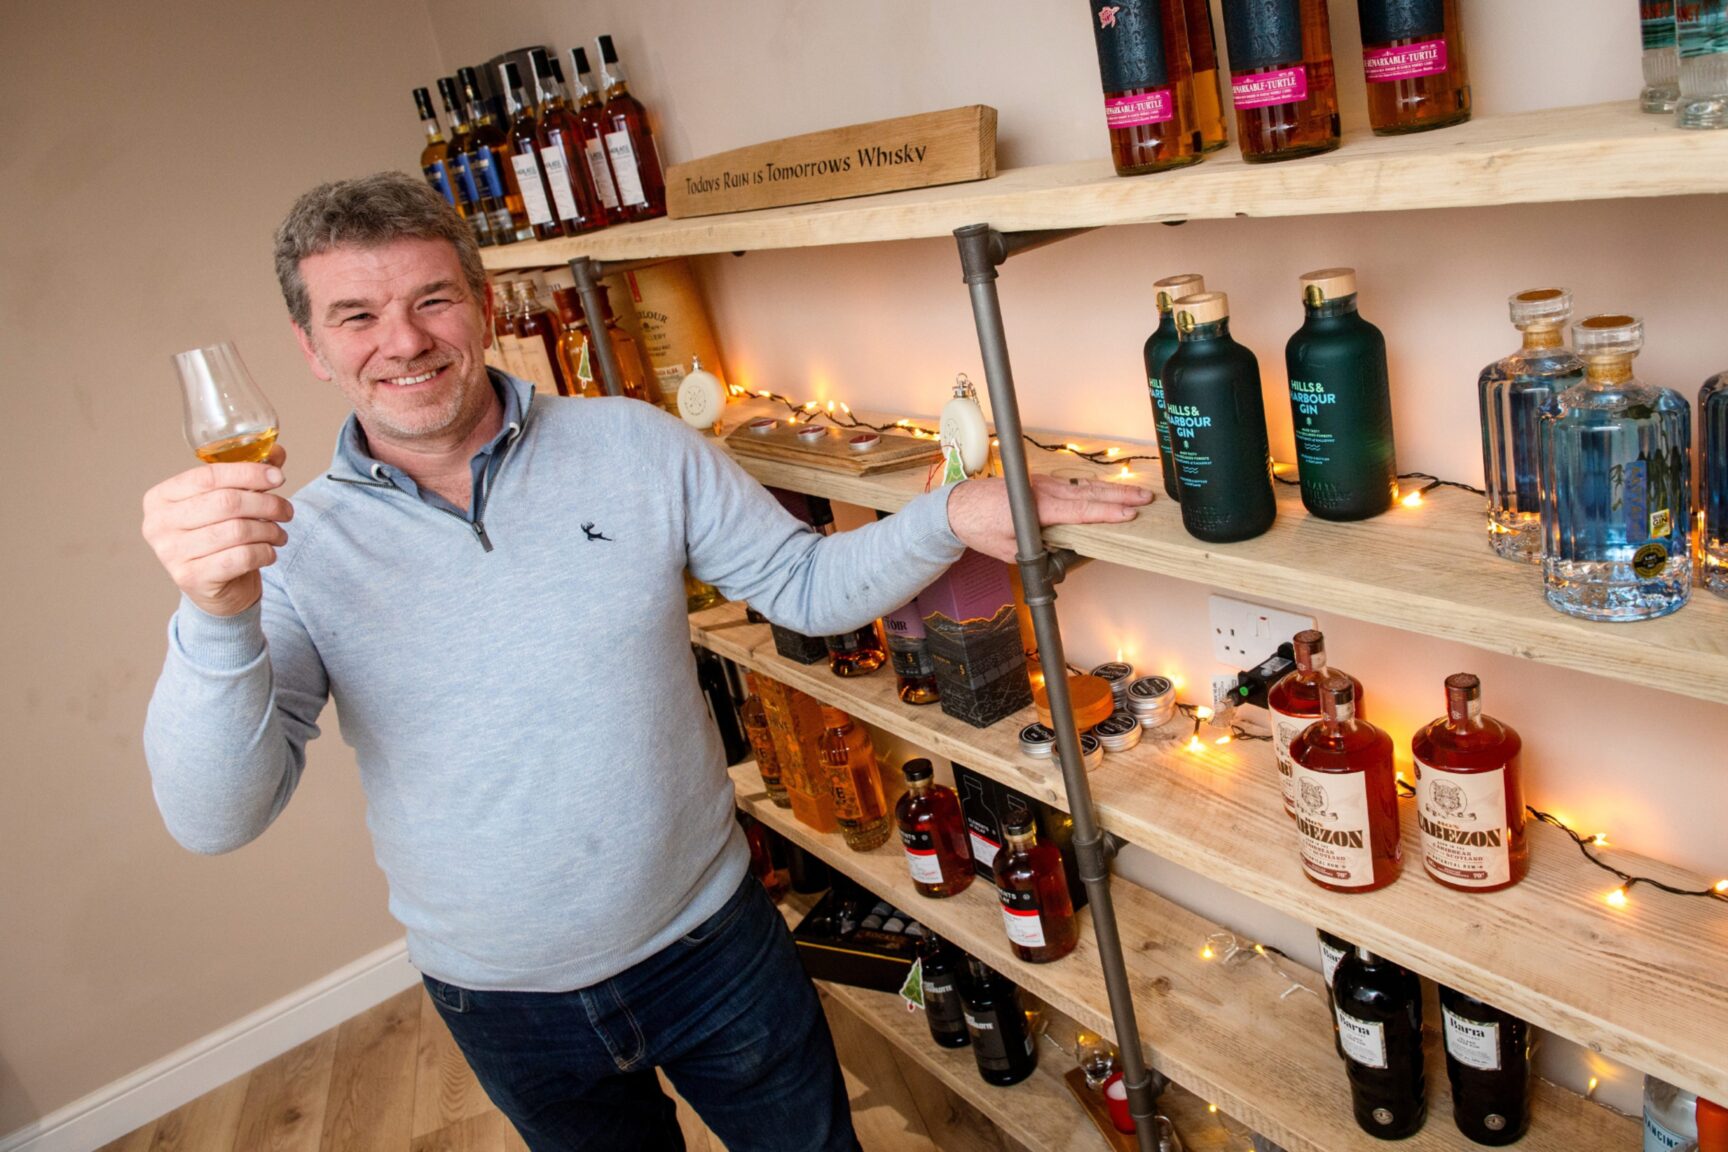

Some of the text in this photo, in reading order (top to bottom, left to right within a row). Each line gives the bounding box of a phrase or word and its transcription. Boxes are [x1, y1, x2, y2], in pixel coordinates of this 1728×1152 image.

[766, 156, 851, 182] Tomorrows
[858, 143, 927, 168] Whisky
[1300, 404, 1318, 415] GIN
[1177, 428, 1194, 438] GIN
